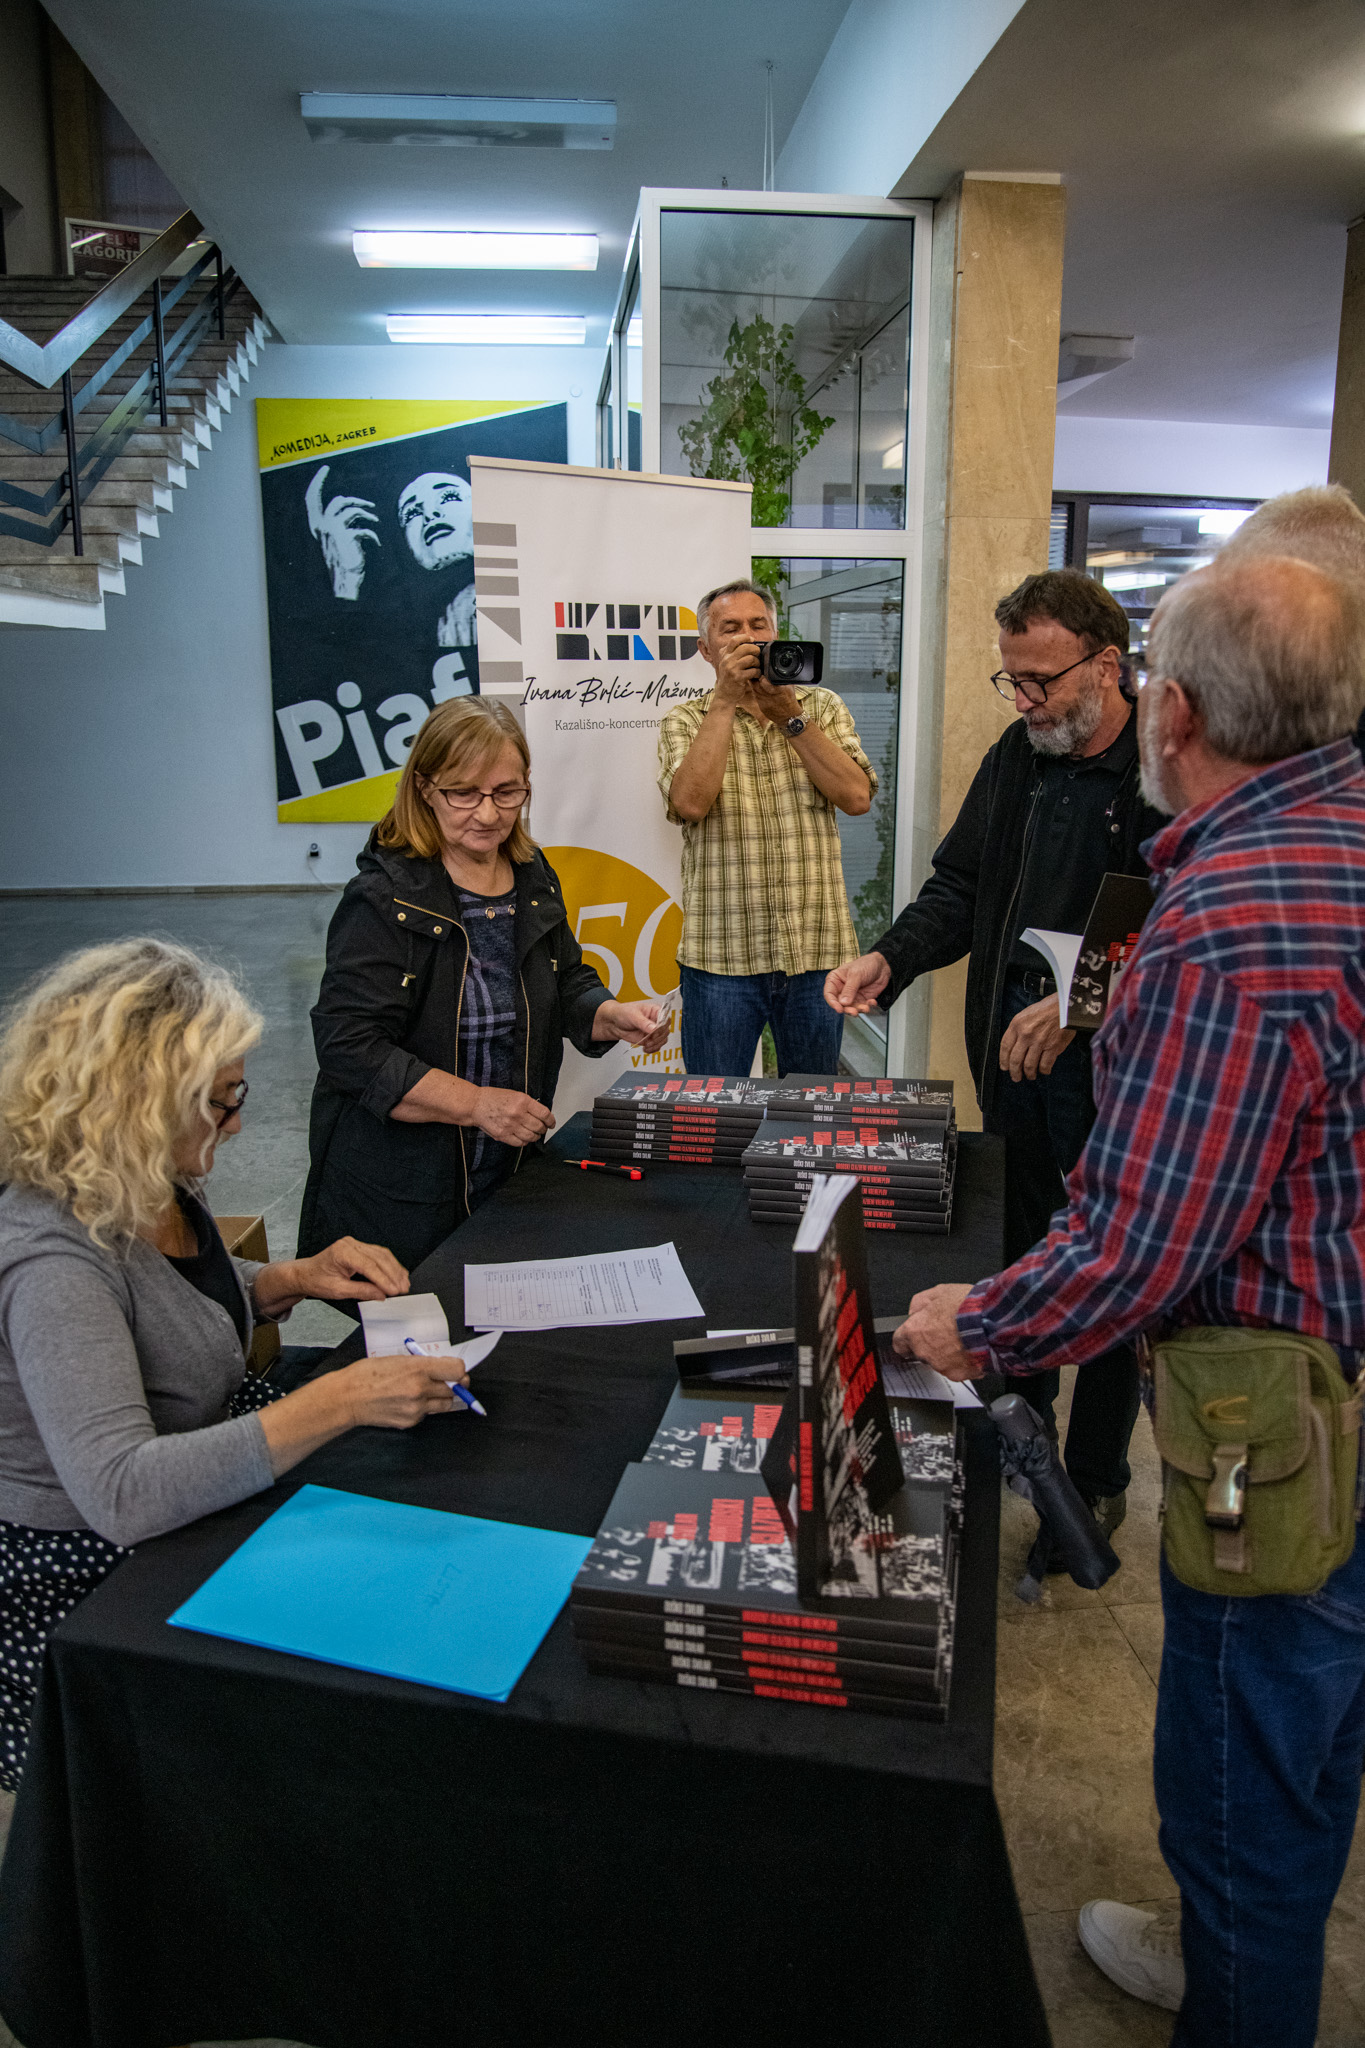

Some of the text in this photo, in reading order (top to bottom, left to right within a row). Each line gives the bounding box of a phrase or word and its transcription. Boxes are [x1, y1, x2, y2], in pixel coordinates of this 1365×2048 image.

[337, 426, 377, 443] ZAGREB
[520, 676, 577, 706] Ivana
[275, 651, 474, 797] Piaf
